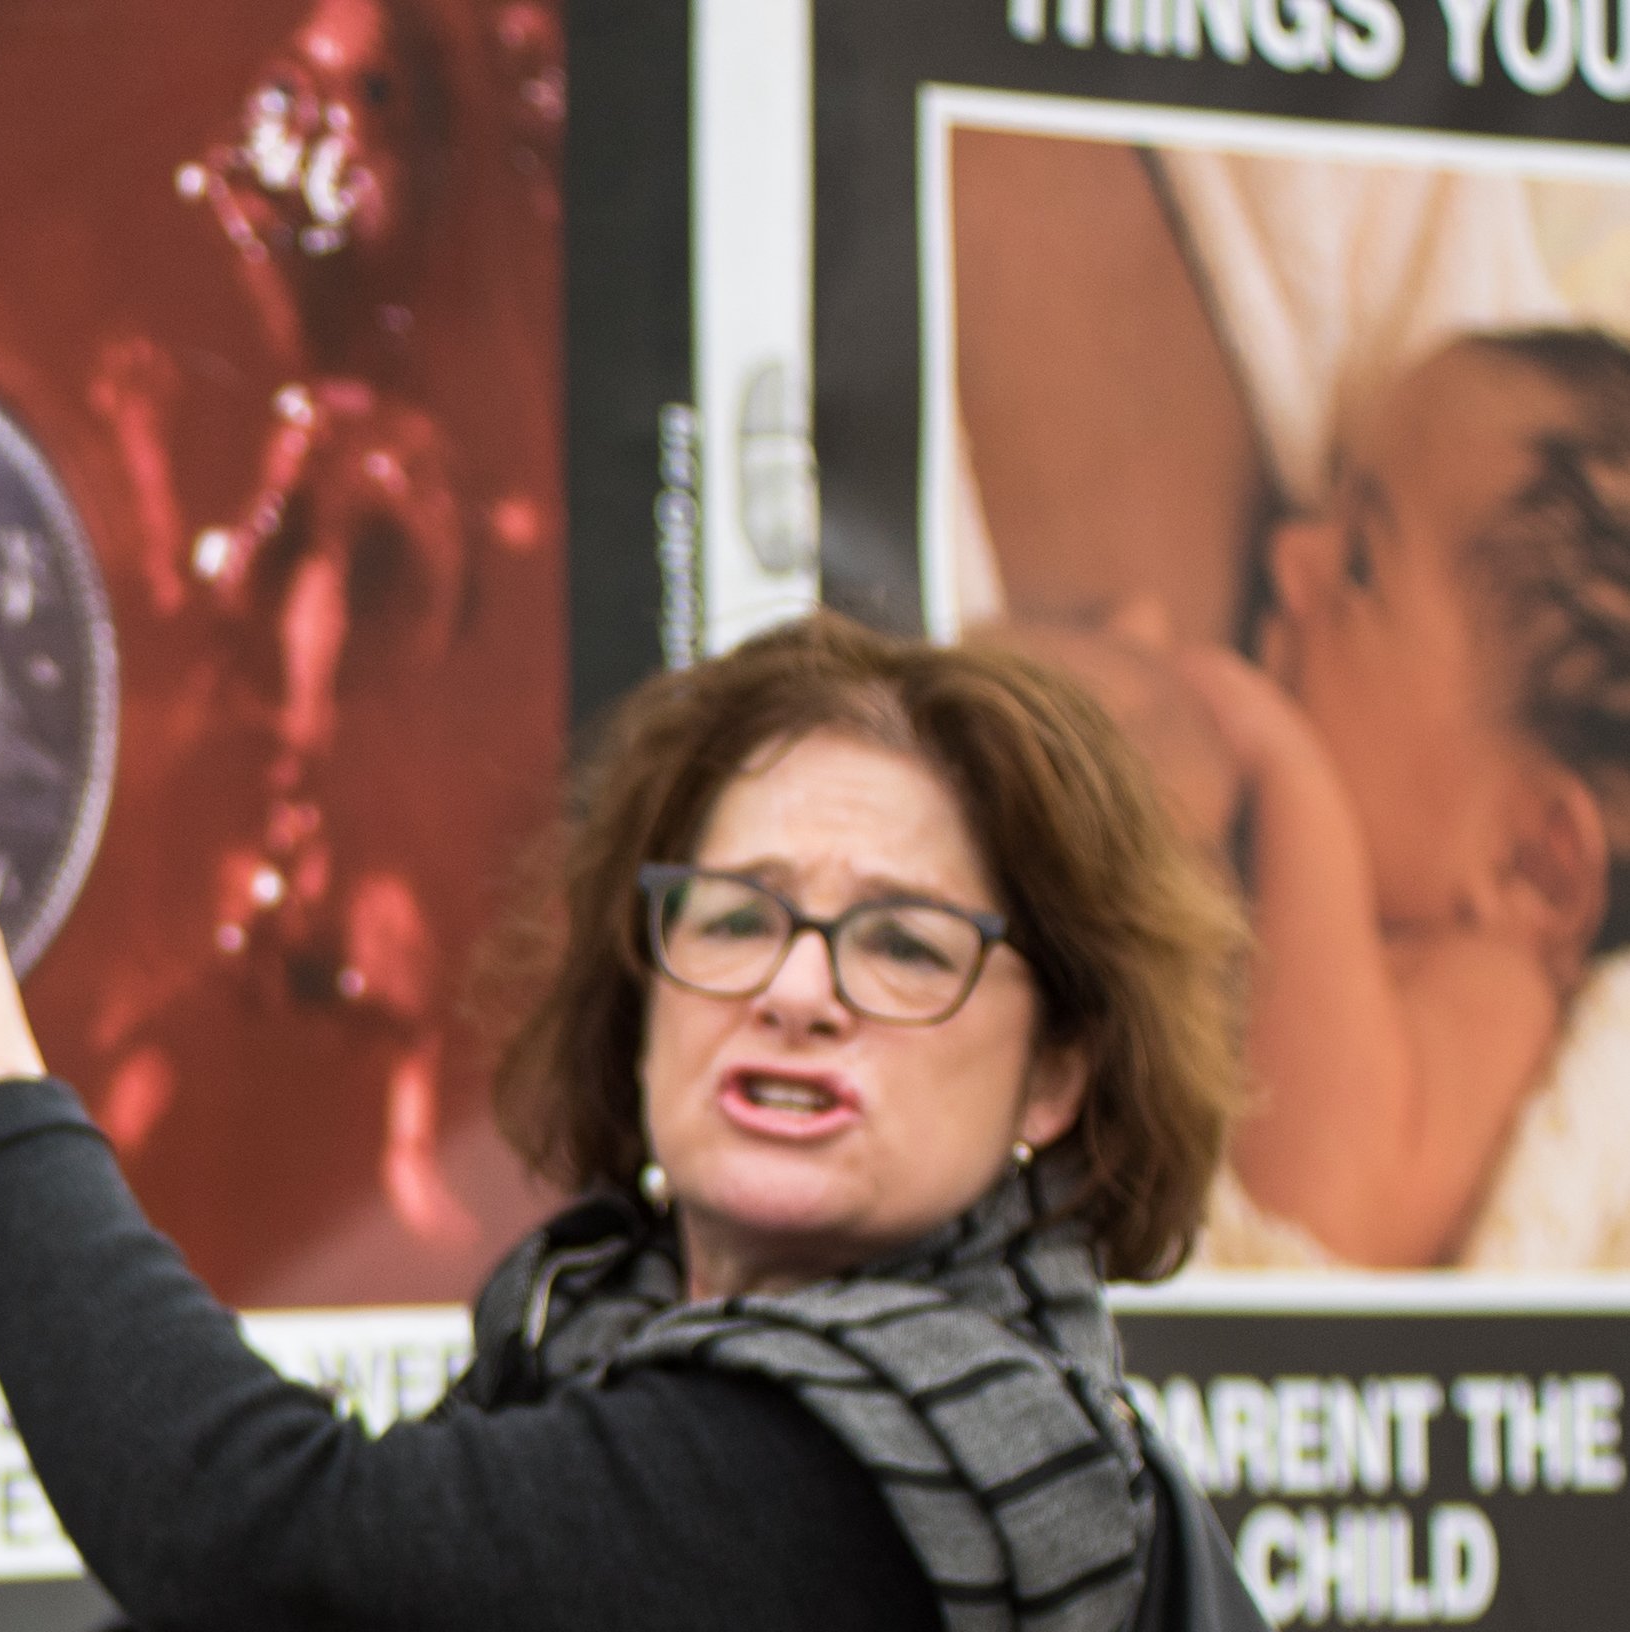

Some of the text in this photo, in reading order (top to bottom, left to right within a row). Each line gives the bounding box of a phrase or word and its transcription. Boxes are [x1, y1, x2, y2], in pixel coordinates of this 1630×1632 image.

[1440, 0, 1630, 102] YOU
[1449, 1372, 1626, 1495] THE
[1235, 1503, 1500, 1625] CHILD
